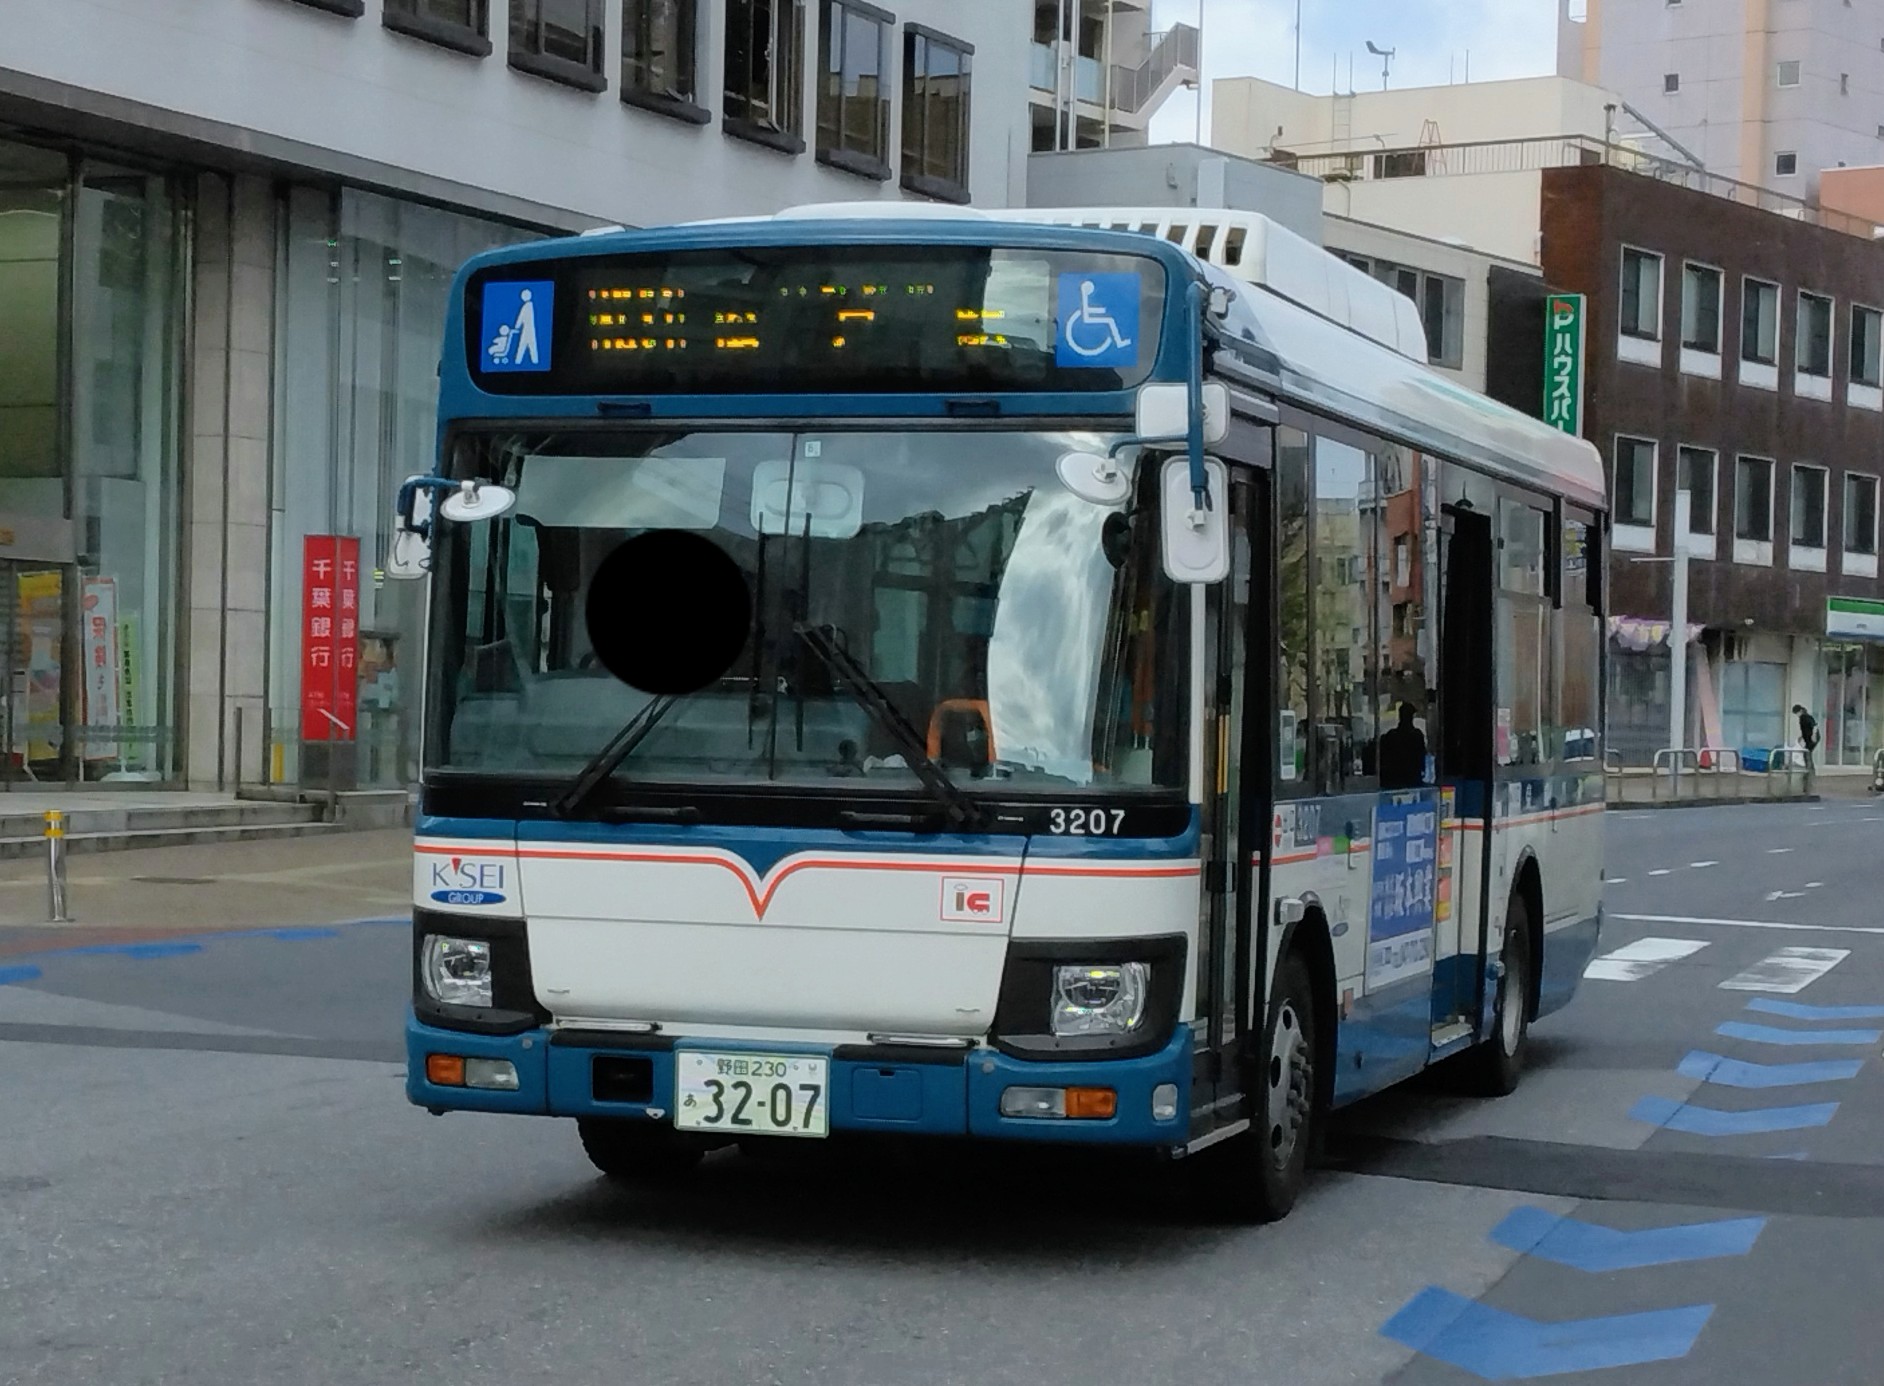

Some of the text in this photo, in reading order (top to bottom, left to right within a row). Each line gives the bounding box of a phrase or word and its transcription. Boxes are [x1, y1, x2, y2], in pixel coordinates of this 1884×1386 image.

[310, 558, 332, 668] 千葉銀行
[1050, 808, 1125, 835] 3207
[447, 891, 484, 904] GROUP
[683, 1079, 821, 1129] あ 32-07
